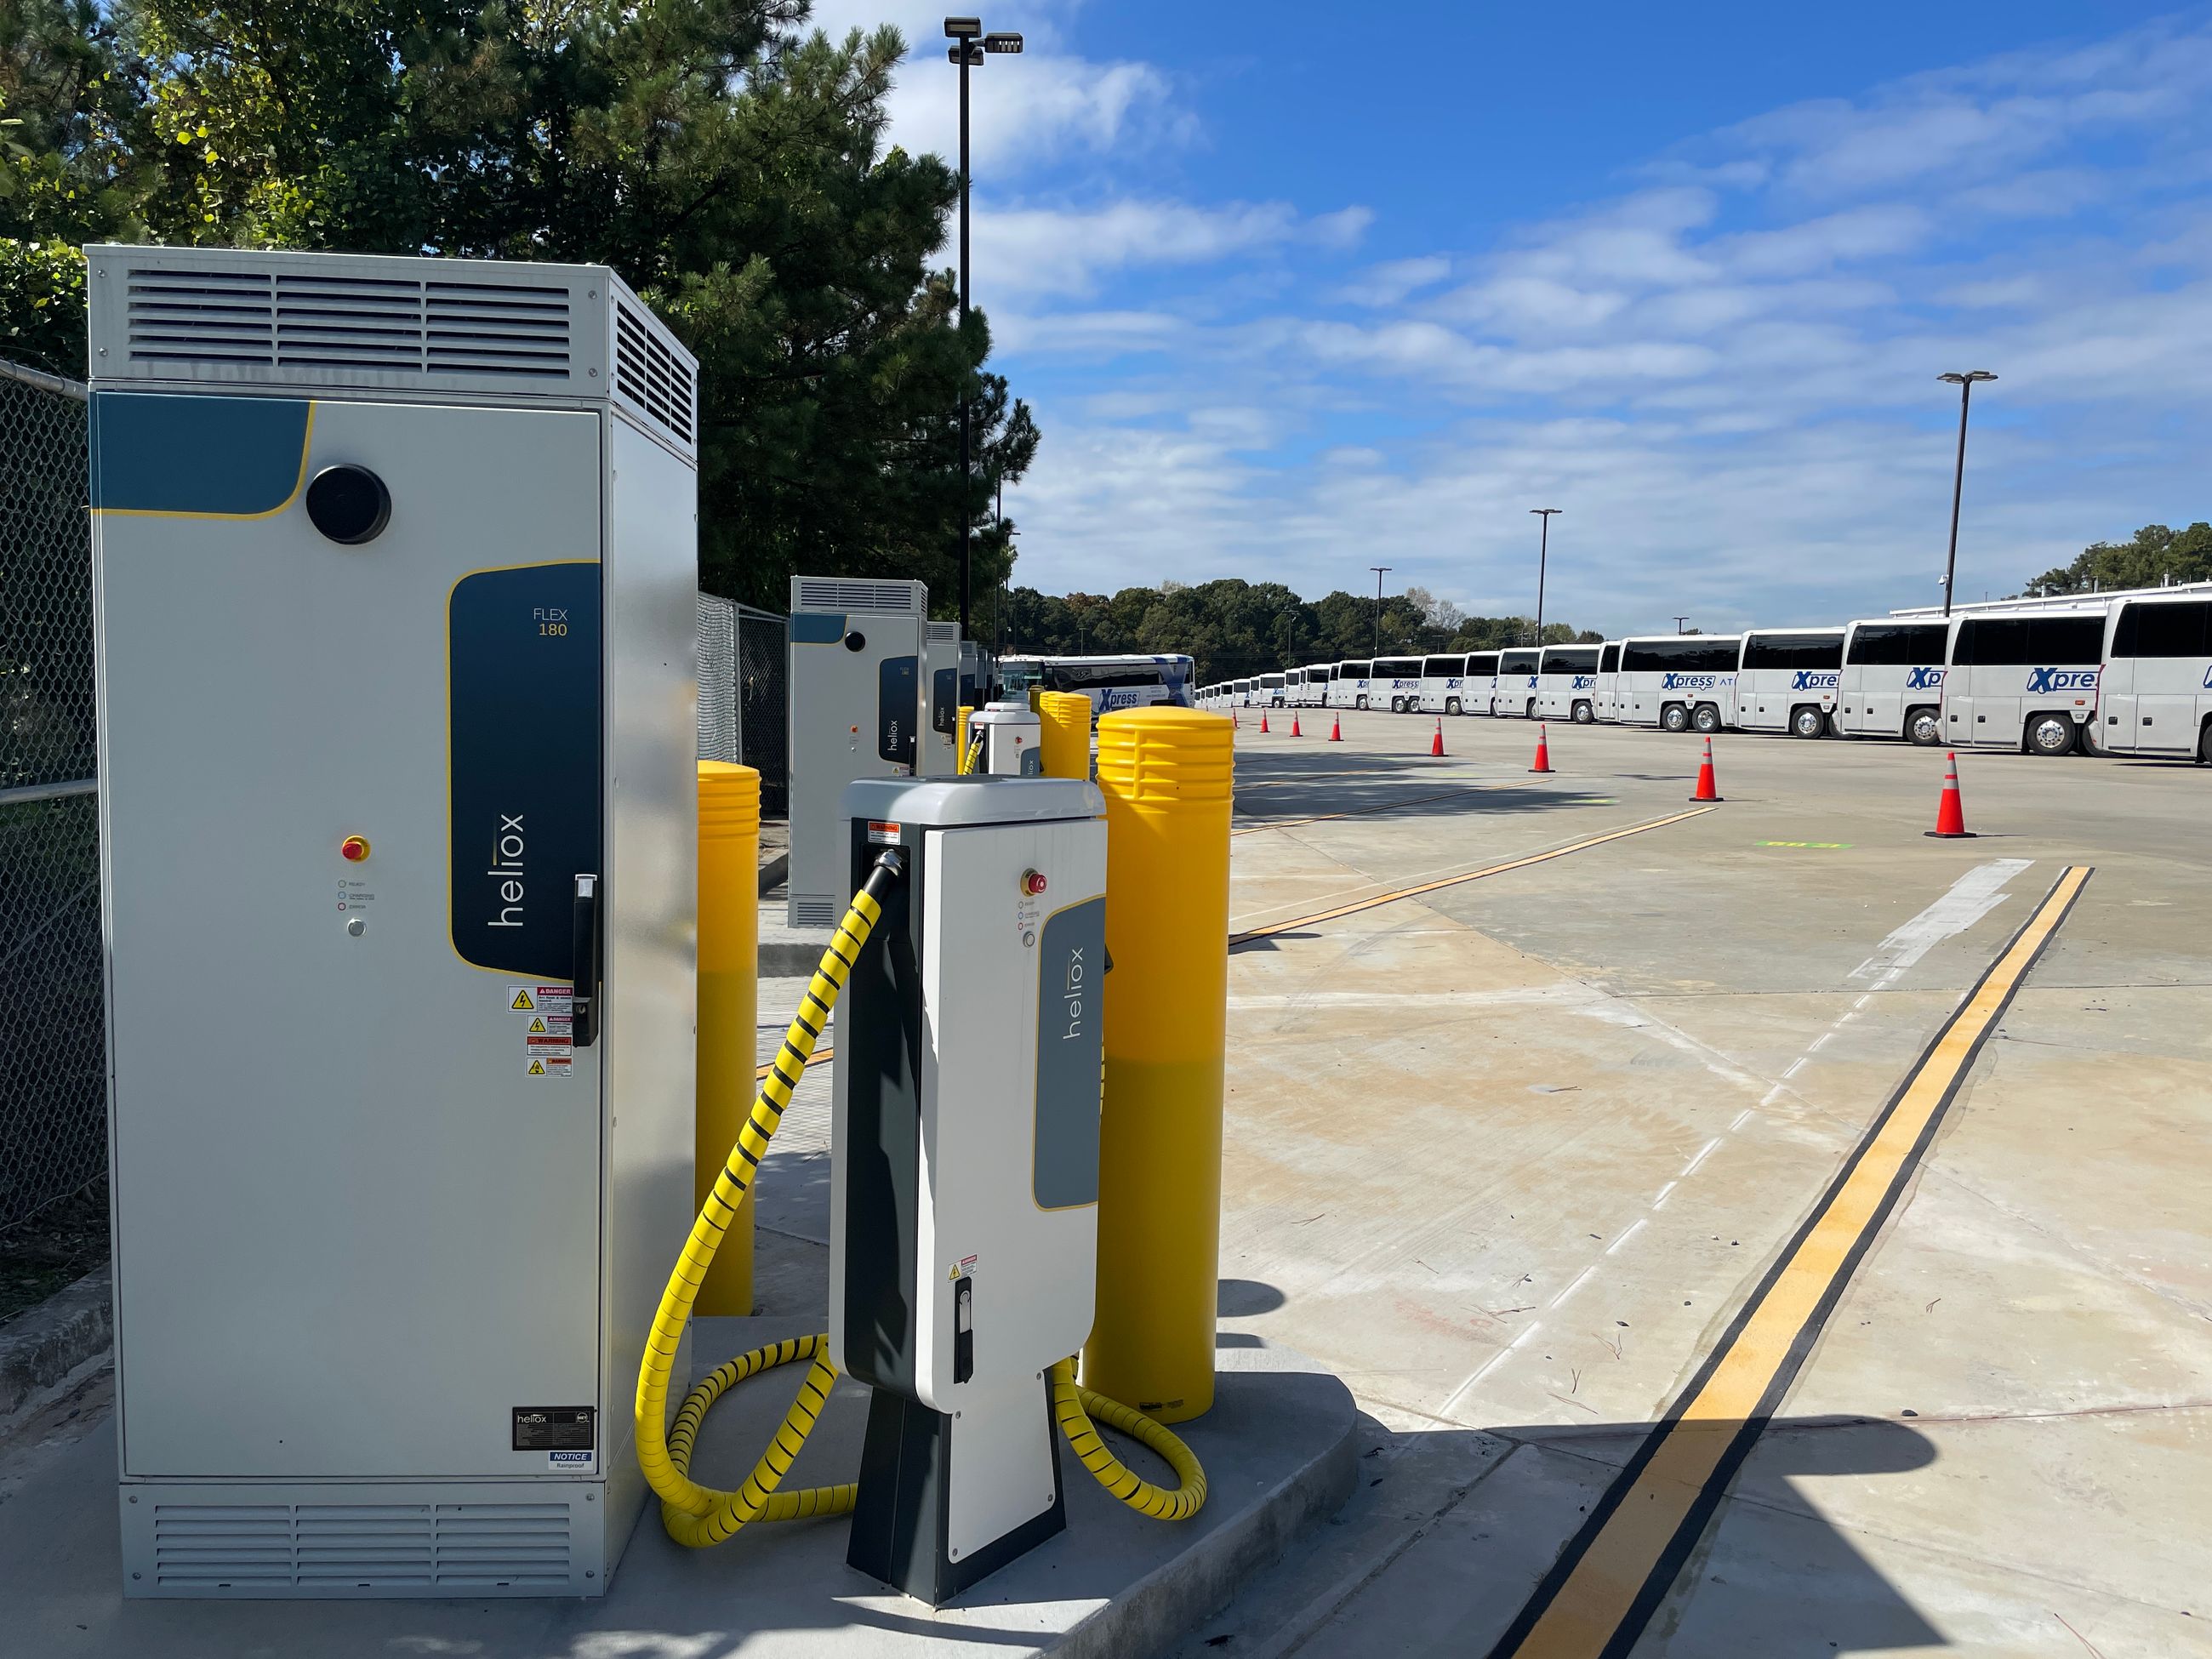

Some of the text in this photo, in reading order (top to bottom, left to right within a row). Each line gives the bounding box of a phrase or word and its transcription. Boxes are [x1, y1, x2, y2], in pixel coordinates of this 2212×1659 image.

[533, 607, 568, 622] FLEX
[538, 623, 567, 637] 180
[1392, 679, 1418, 690] Xpress
[1662, 673, 1715, 689] Xpress
[1792, 670, 1839, 691] Xpre
[2027, 668, 2097, 694] Xpre
[1098, 688, 1138, 710] Xpress
[887, 720, 898, 751] heliox
[487, 813, 524, 927] heliox
[1063, 947, 1084, 1040] heliox
[517, 1414, 547, 1423] heliox
